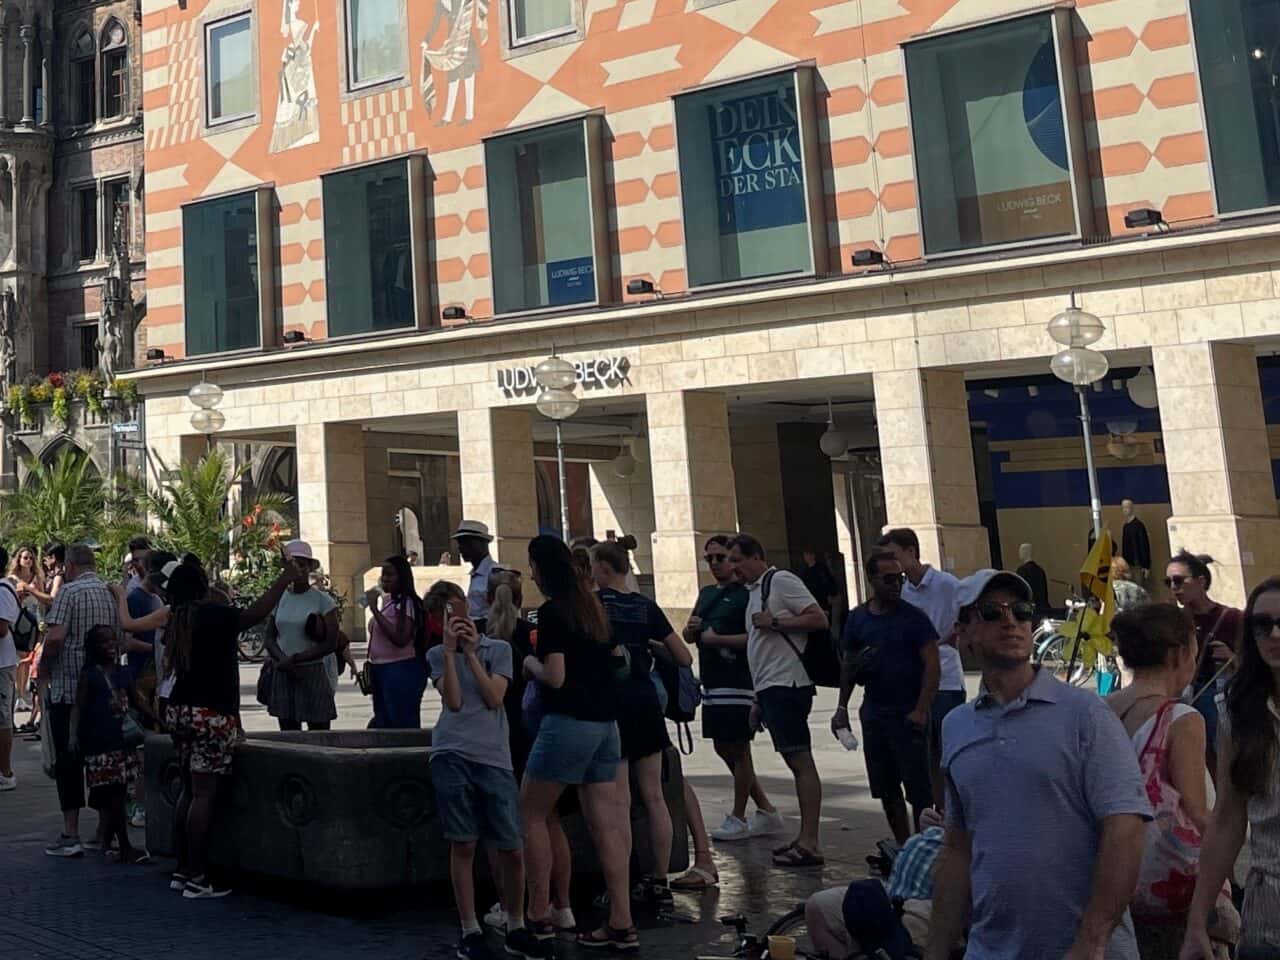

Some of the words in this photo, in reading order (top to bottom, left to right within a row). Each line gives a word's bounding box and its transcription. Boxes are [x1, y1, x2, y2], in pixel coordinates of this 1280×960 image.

[717, 126, 801, 176] ECK
[720, 175, 760, 198] DER
[765, 166, 801, 190] STA
[574, 356, 625, 383] BECK
